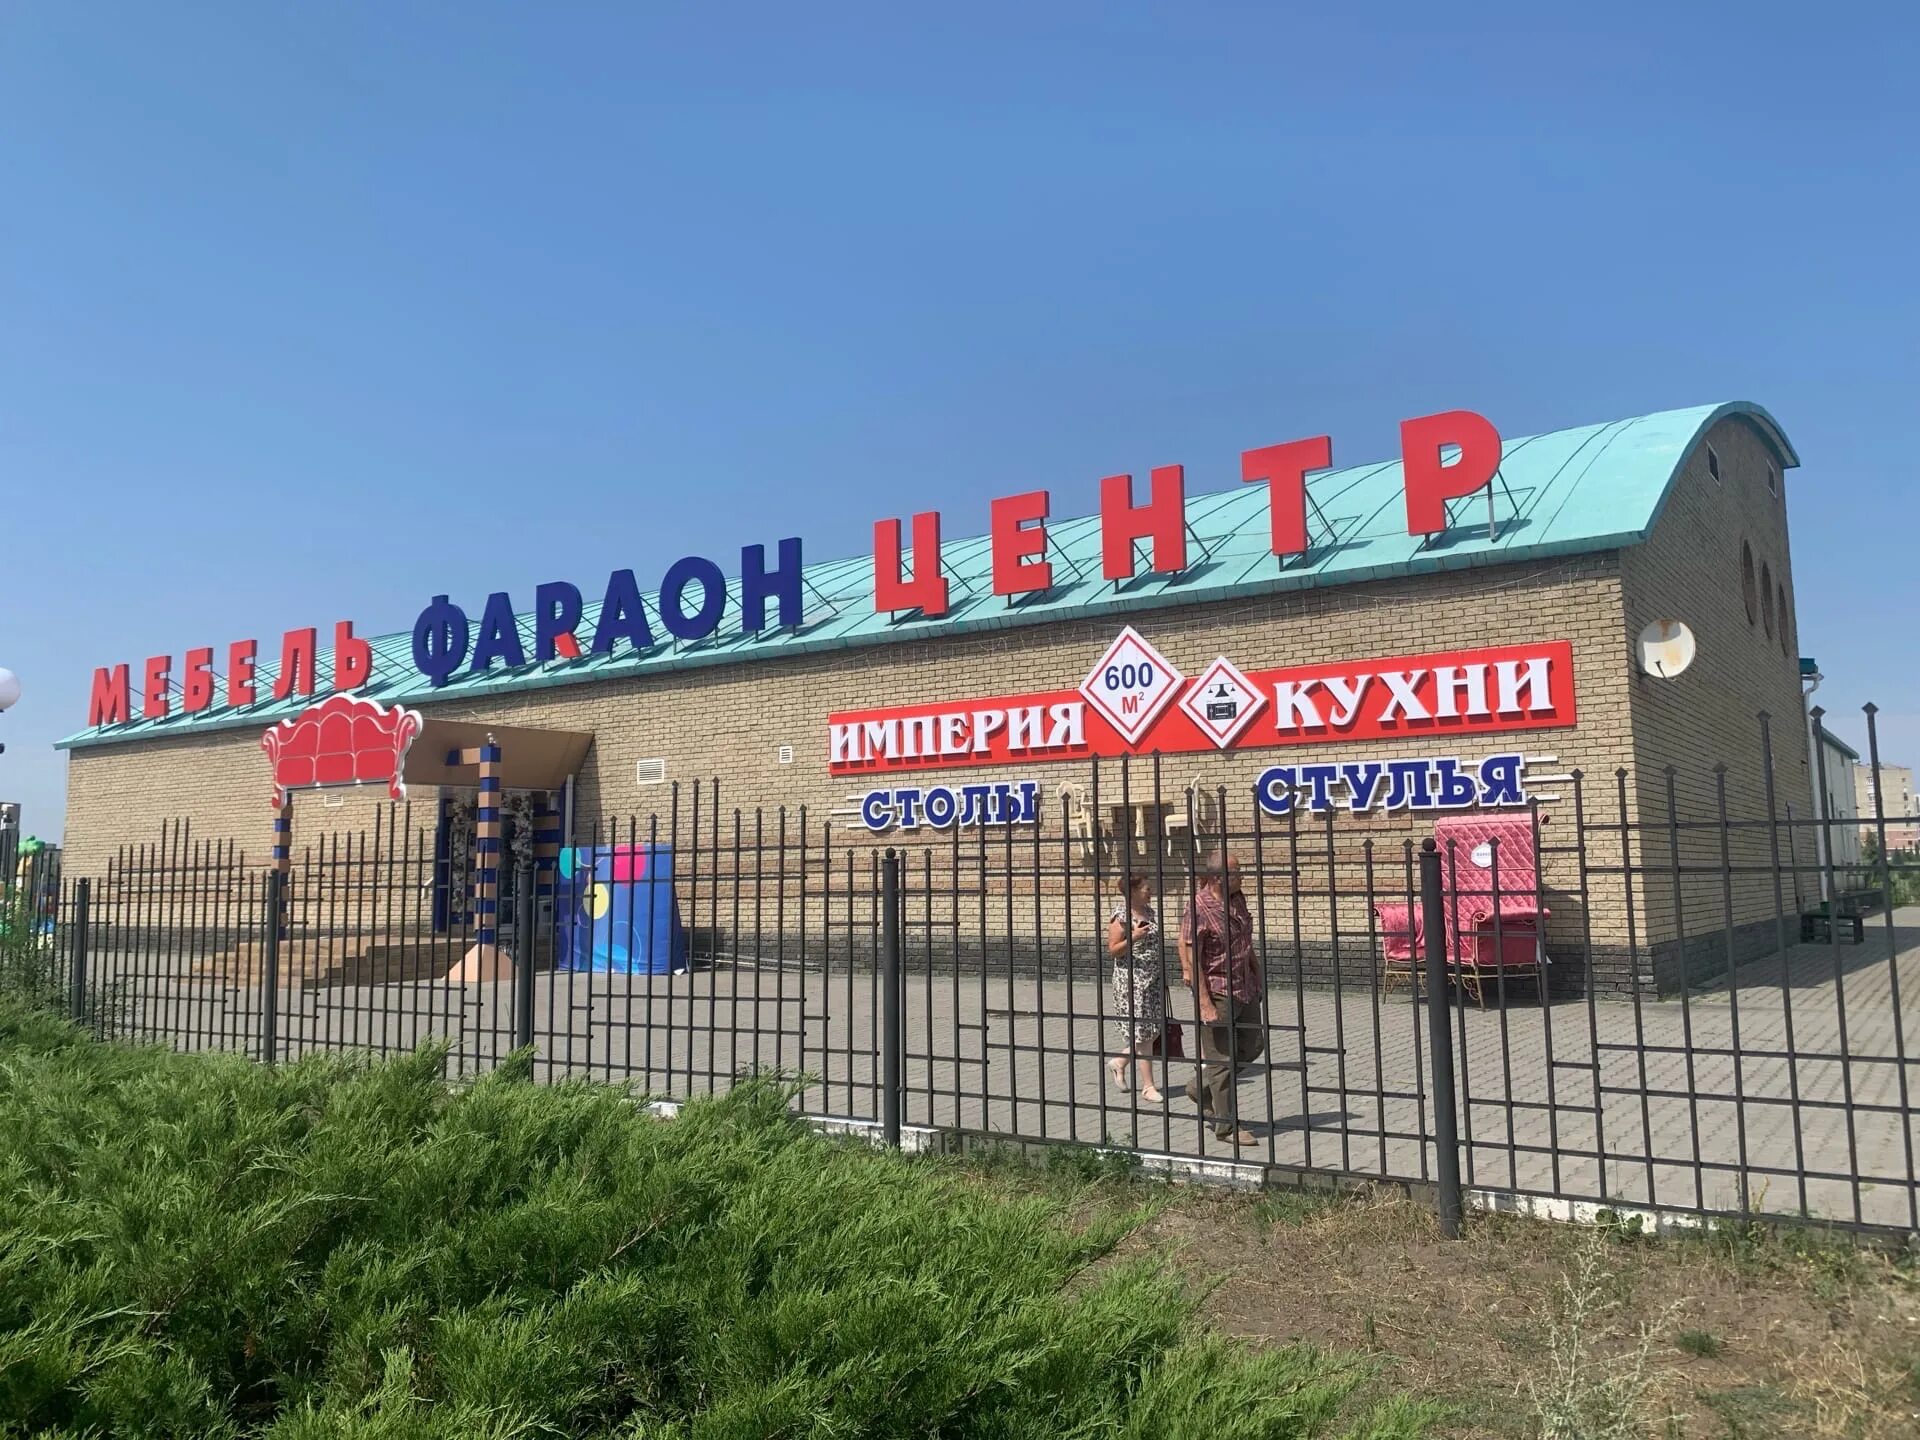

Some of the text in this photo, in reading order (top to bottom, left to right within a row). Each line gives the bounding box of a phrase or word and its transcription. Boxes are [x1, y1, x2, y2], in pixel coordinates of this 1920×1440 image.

[88, 621, 372, 726] МЕБЕЛЬ
[874, 410, 1502, 616] ЦЕНТР
[1105, 662, 1153, 691] 600
[830, 658, 1555, 763] ИМПЕРИЯ КУХНИ
[861, 781, 1040, 830] СТОЛЫ
[1257, 752, 1527, 814] СТУЛЬЯ
